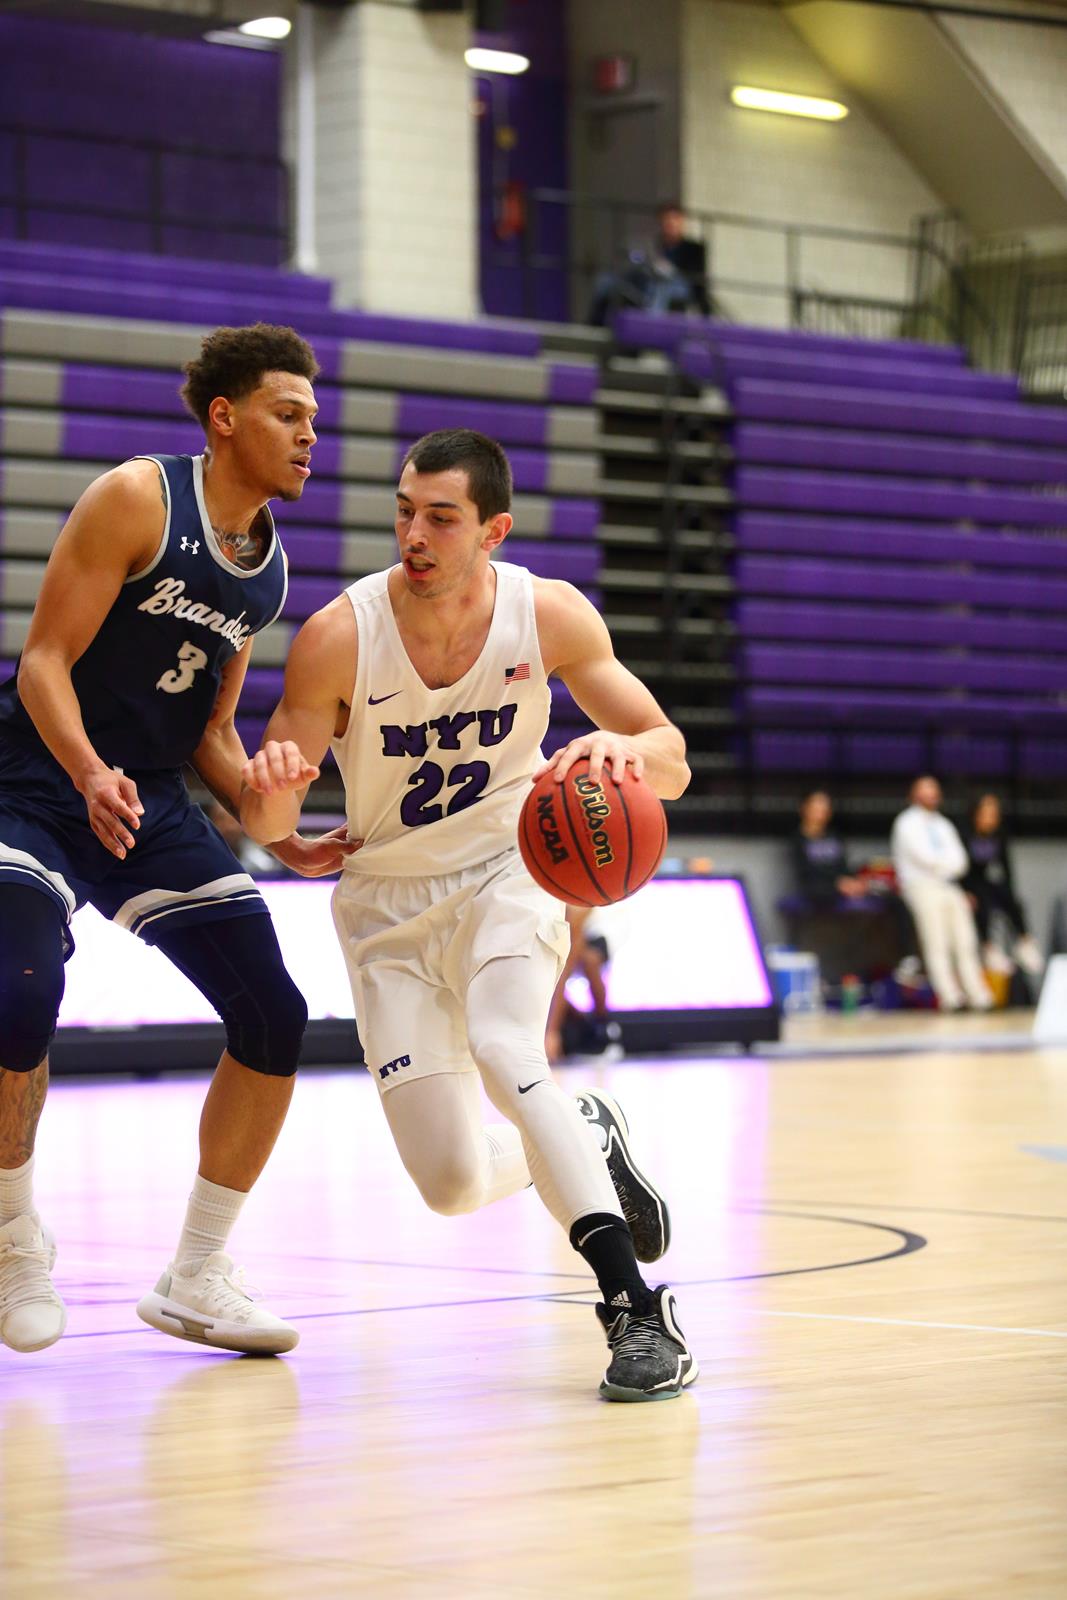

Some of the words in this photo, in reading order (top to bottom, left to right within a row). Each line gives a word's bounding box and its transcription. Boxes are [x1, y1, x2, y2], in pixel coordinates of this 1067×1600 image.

[156, 641, 208, 694] 3
[380, 703, 518, 758] NYU
[400, 760, 491, 827] 22
[573, 773, 614, 867] Wilson
[537, 793, 570, 865] NCAA
[378, 1054, 412, 1080] NYU
[610, 1299, 632, 1308] adidas
